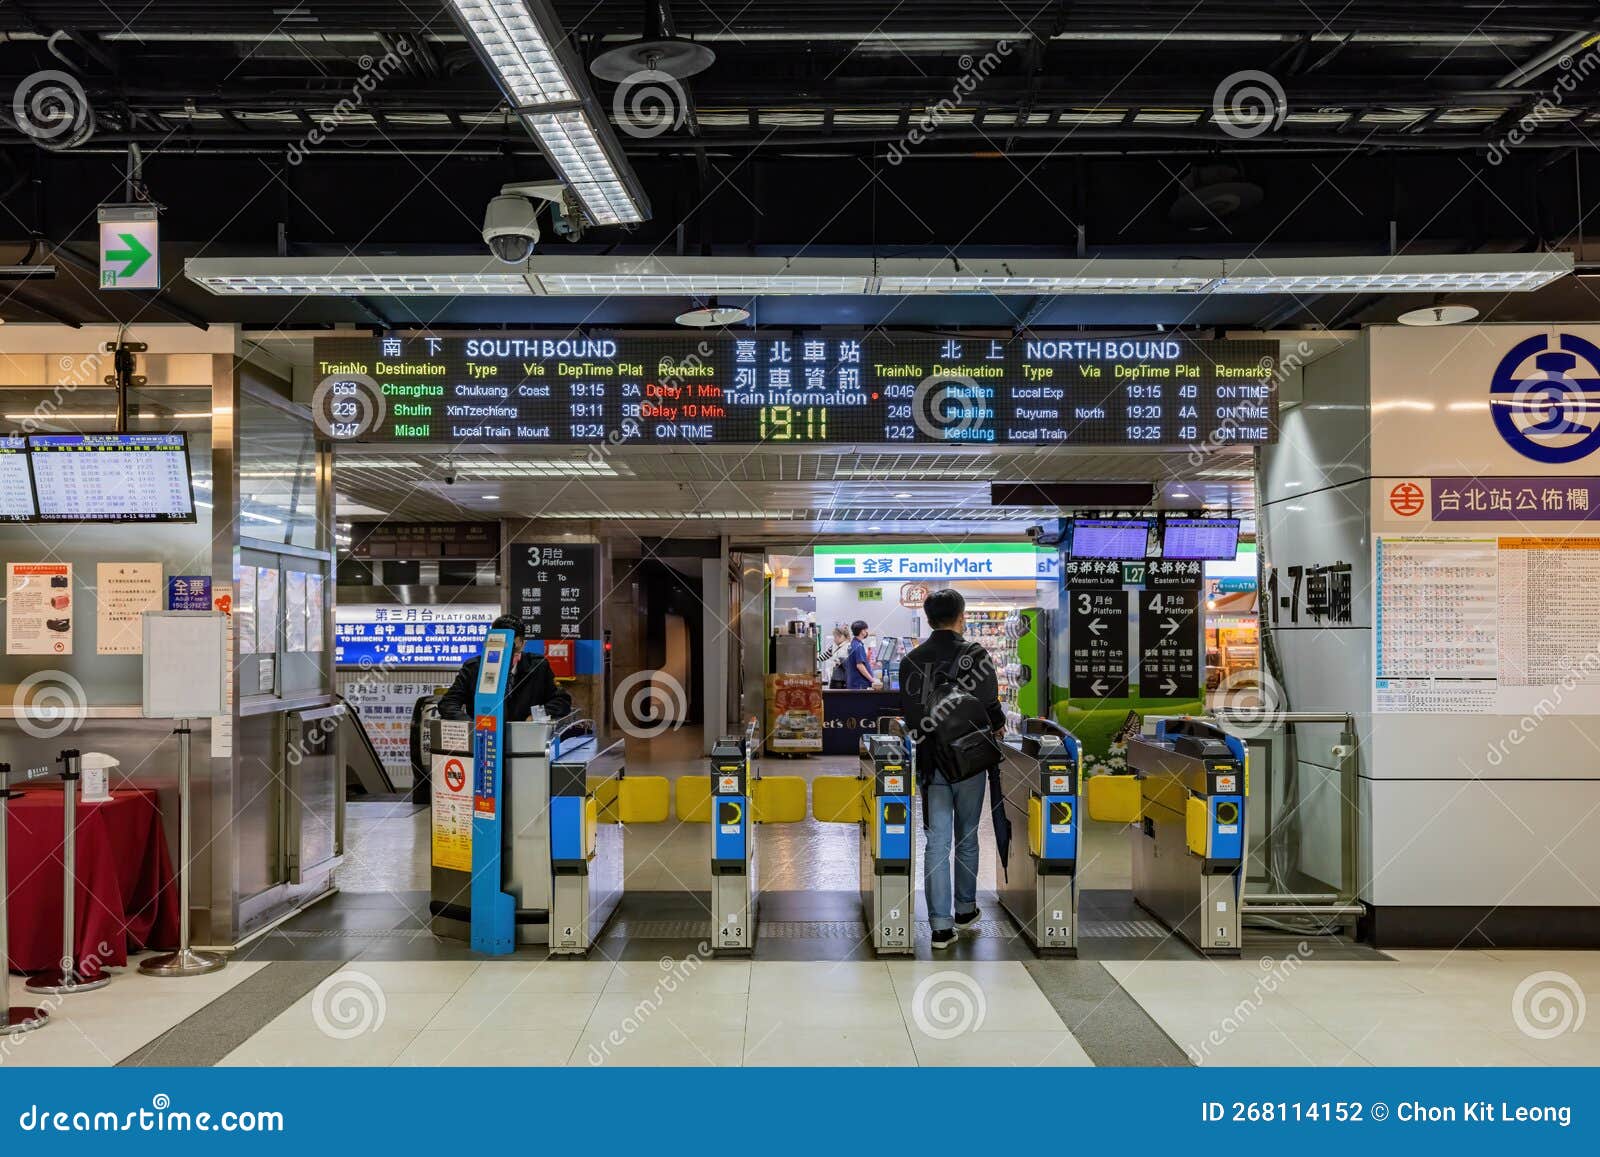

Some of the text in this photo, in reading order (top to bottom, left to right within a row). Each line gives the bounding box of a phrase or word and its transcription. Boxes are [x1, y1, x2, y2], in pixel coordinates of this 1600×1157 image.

[382, 338, 443, 357] 南下
[735, 340, 861, 363] 臺北車站
[941, 340, 1005, 360] 北上
[320, 362, 715, 379] TrainNo Destination Type Via DepTime Plat Remarks
[874, 365, 1272, 380] TrainNo Destination Type Via DepTime Plat Remarks
[735, 367, 861, 390] 列車資訊
[333, 383, 724, 399] 653 Changhua Chukuang Coast 19:15 3A Delay 1 Min.
[724, 389, 867, 405] Train Information
[884, 386, 915, 398] 4046
[1012, 387, 1040, 398] Local
[1042, 387, 1064, 400] Exp
[1126, 386, 1161, 398] 19:15
[1178, 386, 1197, 398] 4B
[1216, 386, 1236, 398] ON
[1239, 386, 1269, 398] TIME
[333, 404, 357, 416] 229
[394, 404, 432, 417] Shulin
[570, 404, 603, 417] 19:11
[622, 405, 641, 417] 3B
[642, 405, 677, 419] Delay
[683, 405, 697, 417] 10
[701, 405, 727, 417] Min.
[888, 406, 912, 419] 248
[1016, 408, 1058, 421] Puyuma
[1075, 408, 1105, 419] North
[1126, 406, 1161, 419] 19:20
[1178, 406, 1198, 419] 4A
[759, 406, 828, 440] 19:11
[329, 424, 713, 438] 1247 Miaoli Local Train Mount 19:24 3A ON TIME
[884, 427, 915, 439] 1242
[944, 427, 995, 442] Keelung
[1009, 428, 1038, 439] Local
[1040, 428, 1067, 439] Train
[1126, 427, 1161, 439] 19:25
[1178, 427, 1197, 439] 4B
[1439, 487, 1590, 512] 台北站公佈欄
[527, 546, 541, 567] 3
[542, 548, 563, 559] 月台
[542, 559, 574, 567] Platform
[862, 557, 993, 576] 全家 FamilyMart
[1066, 562, 1120, 575] 西部幹線
[1148, 562, 1201, 575] 東部幹線
[537, 571, 548, 582] 往
[1124, 567, 1145, 583] L27
[174, 579, 205, 596] 全票
[1239, 582, 1256, 590] ATM
[1078, 594, 1092, 615] 3
[1094, 596, 1113, 605] 月台
[1148, 594, 1164, 615] 4
[1166, 596, 1184, 605] 月台
[376, 608, 433, 622] 第三月台
[561, 606, 580, 615] 台中
[374, 625, 396, 635] 台中
[822, 718, 844, 729] et's
[565, 927, 572, 935] 4
[722, 928, 742, 936] 4 3
[884, 927, 905, 936] 3 2
[1047, 927, 1055, 936] 2
